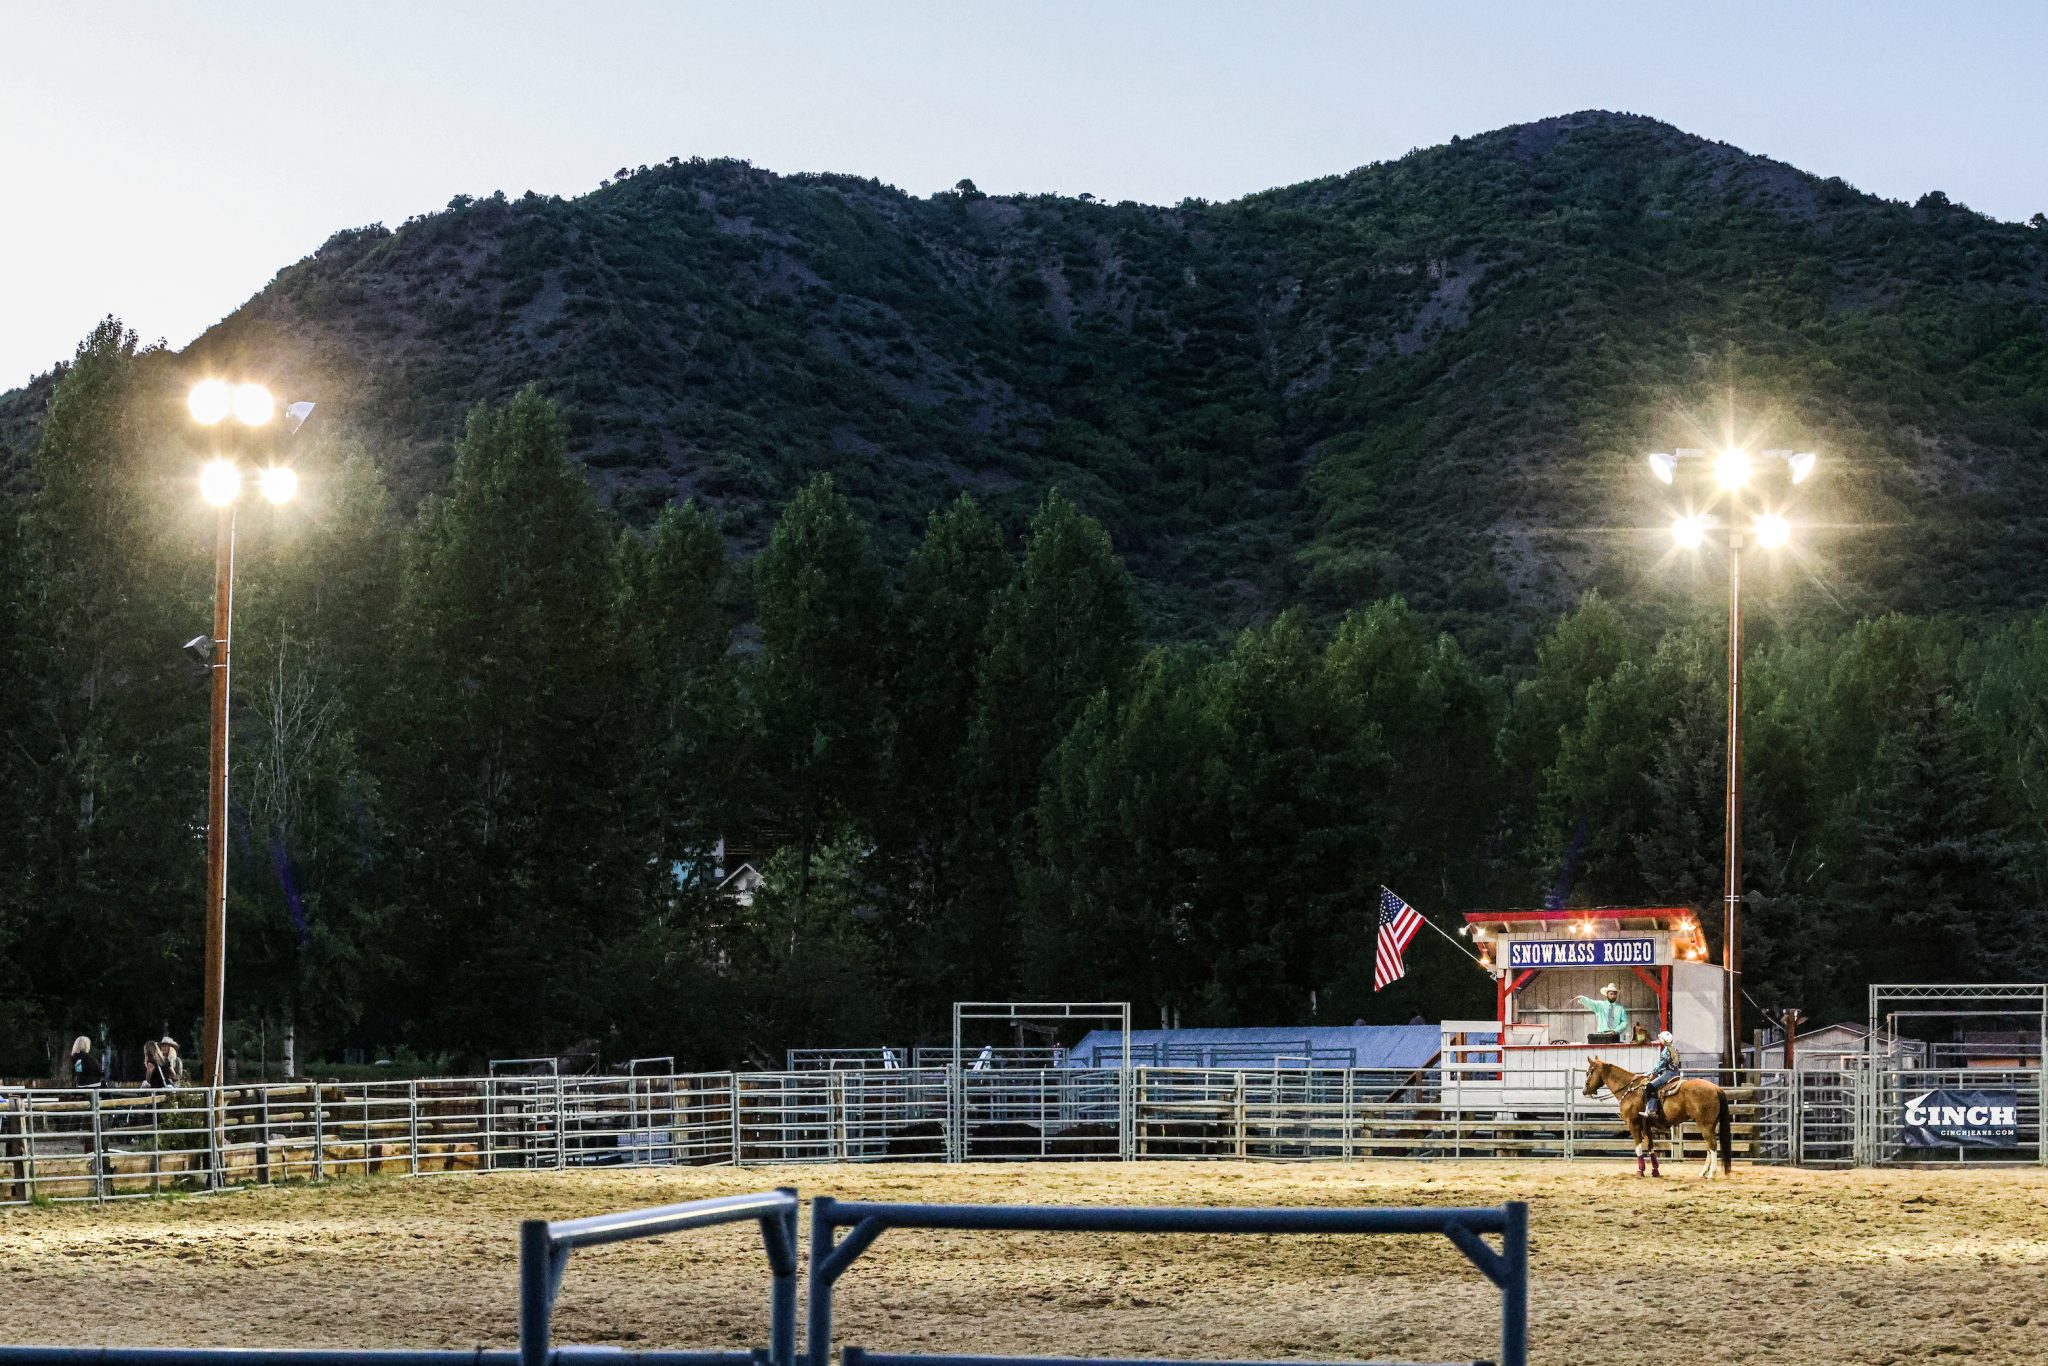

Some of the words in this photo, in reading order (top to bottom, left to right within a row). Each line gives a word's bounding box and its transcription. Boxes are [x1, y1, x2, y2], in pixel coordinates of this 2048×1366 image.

[1512, 942, 1595, 964] SNOWMASS
[1603, 941, 1652, 962] RODEO
[1905, 1106, 2014, 1126] CINCH
